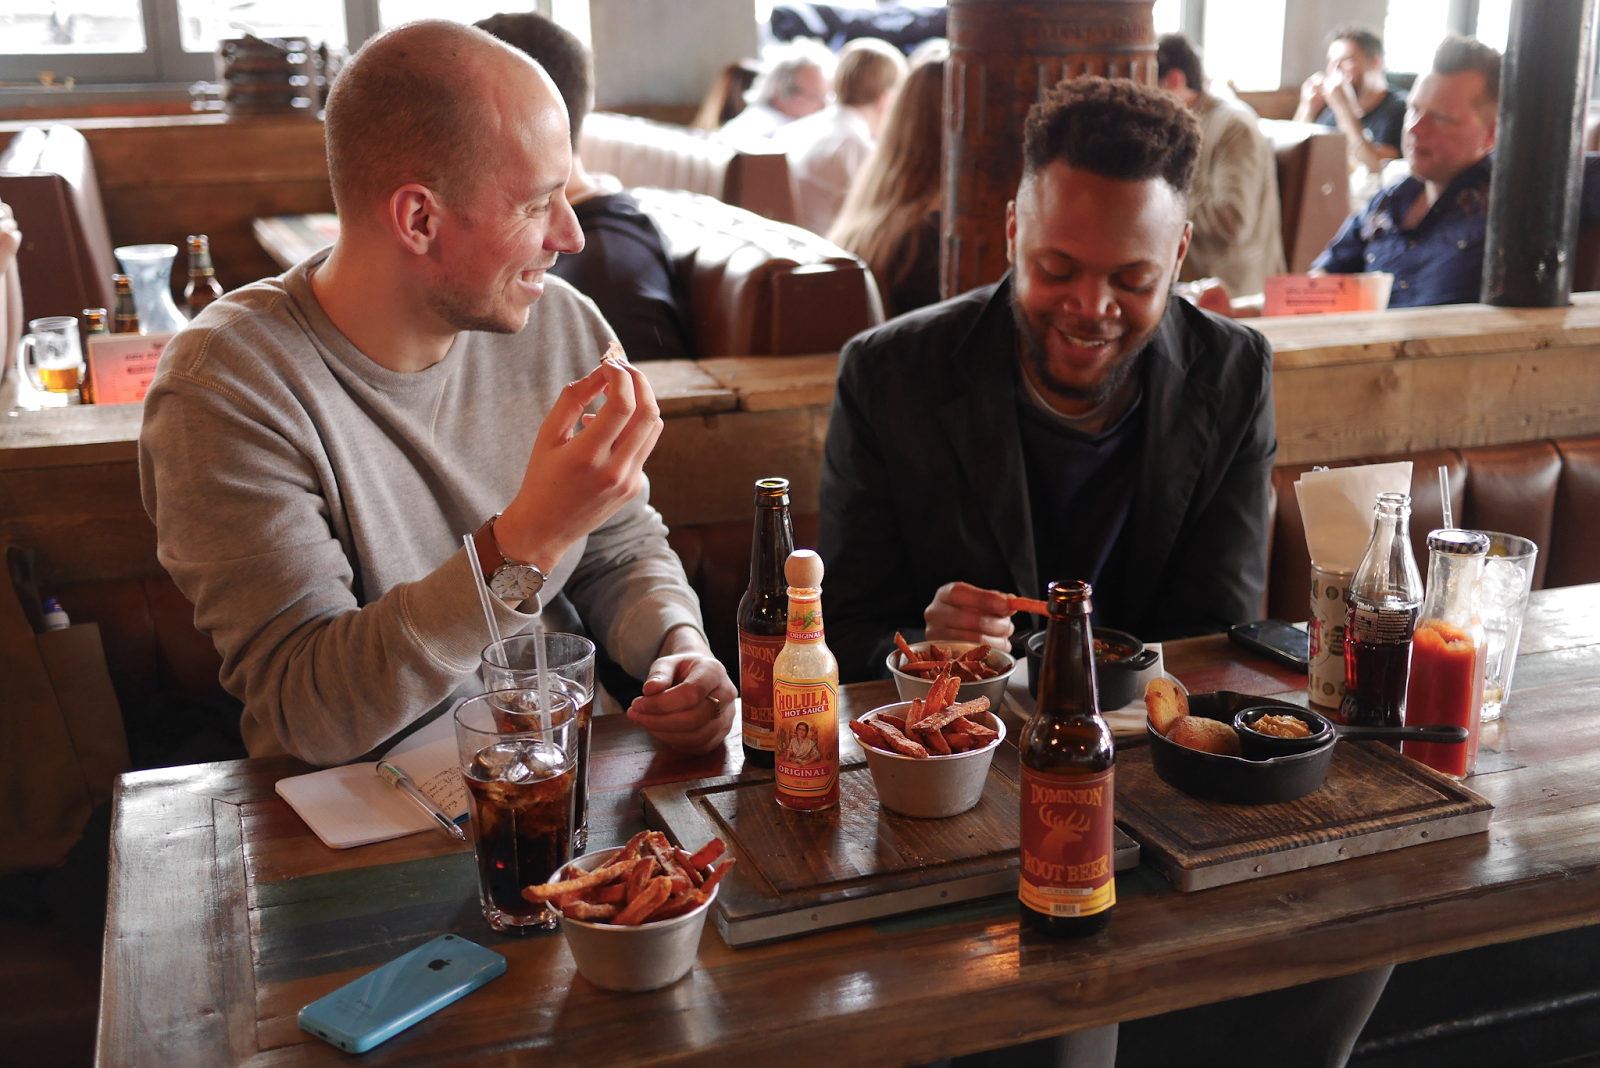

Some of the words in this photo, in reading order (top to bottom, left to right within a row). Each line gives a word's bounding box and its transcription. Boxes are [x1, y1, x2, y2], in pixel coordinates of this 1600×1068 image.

[789, 631, 822, 640] ORIGINAL
[775, 689, 830, 714] CHOLULA
[750, 706, 775, 722] BEE
[784, 709, 801, 718] HOT
[802, 705, 826, 715] SAUCE
[778, 764, 826, 777] ORIGINAL
[1031, 784, 1104, 807] DOMINION
[1024, 848, 1065, 881] ROOT
[1067, 855, 1109, 882] BEER
